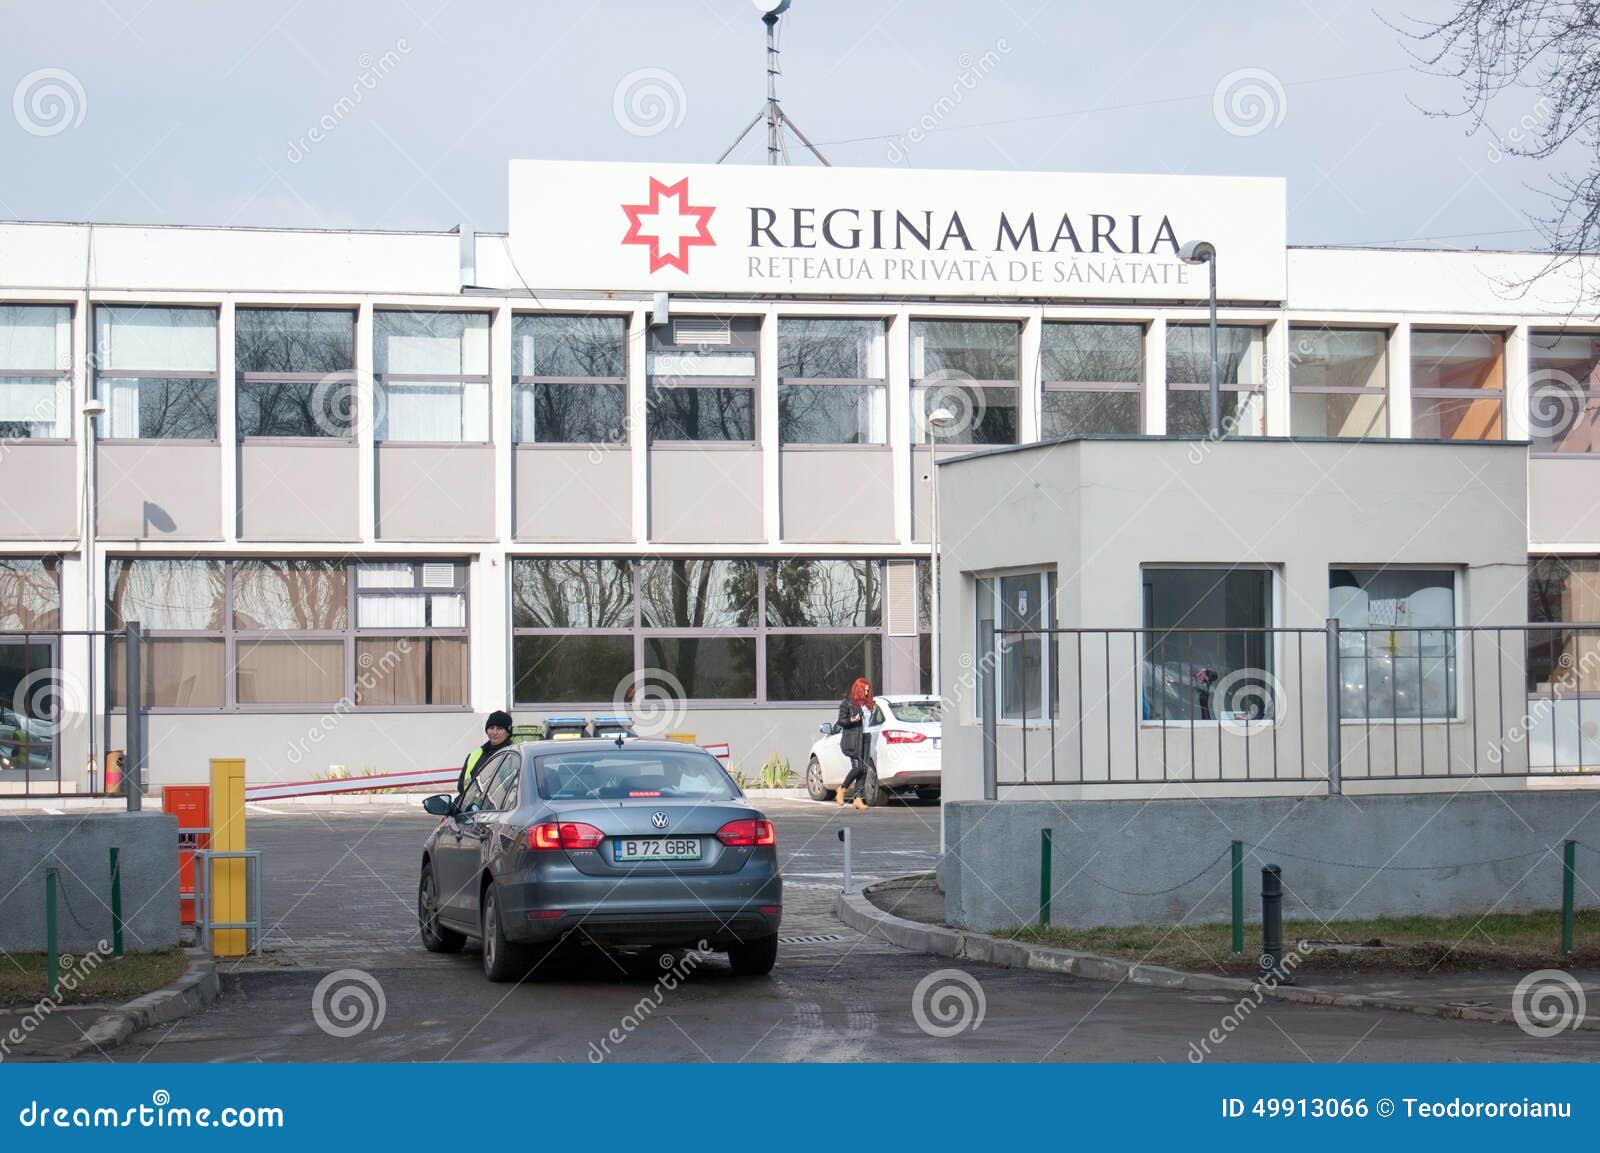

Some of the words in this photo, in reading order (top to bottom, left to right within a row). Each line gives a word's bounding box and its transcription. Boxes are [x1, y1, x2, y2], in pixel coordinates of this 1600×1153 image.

[747, 206, 976, 251] REGINA
[992, 210, 1181, 255] MARIA
[748, 256, 873, 284] REȚEAUA
[884, 256, 999, 282] PRIVATĂ
[1008, 260, 1044, 282] DE
[1053, 256, 1189, 285] SĂNĂTATE
[627, 841, 638, 855] B
[643, 841, 661, 855] 72
[665, 840, 697, 855] GBR
